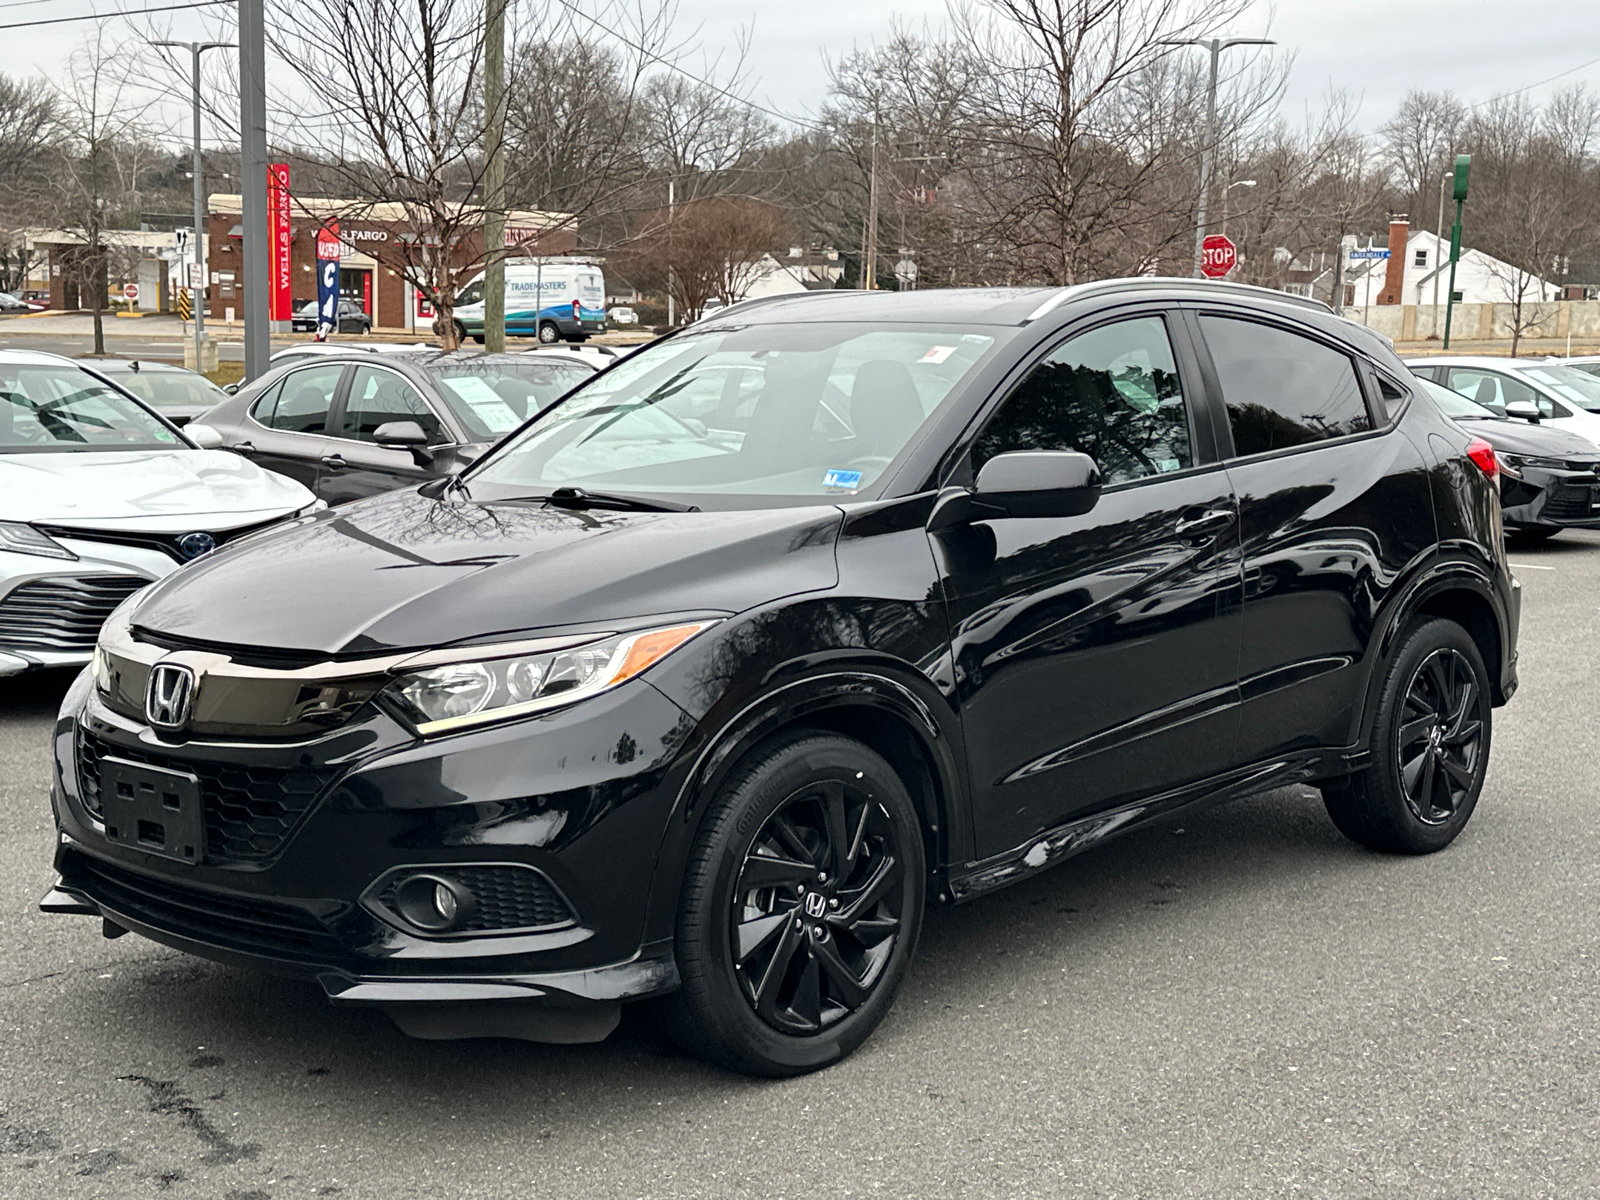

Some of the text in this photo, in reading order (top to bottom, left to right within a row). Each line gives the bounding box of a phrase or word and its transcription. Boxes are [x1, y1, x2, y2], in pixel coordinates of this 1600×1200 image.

[279, 171, 289, 290] WELLS FARGO
[350, 230, 388, 241] FARGO
[318, 241, 339, 258] USED
[1201, 247, 1234, 265] STOP
[511, 281, 567, 291] TRADEMASTERS
